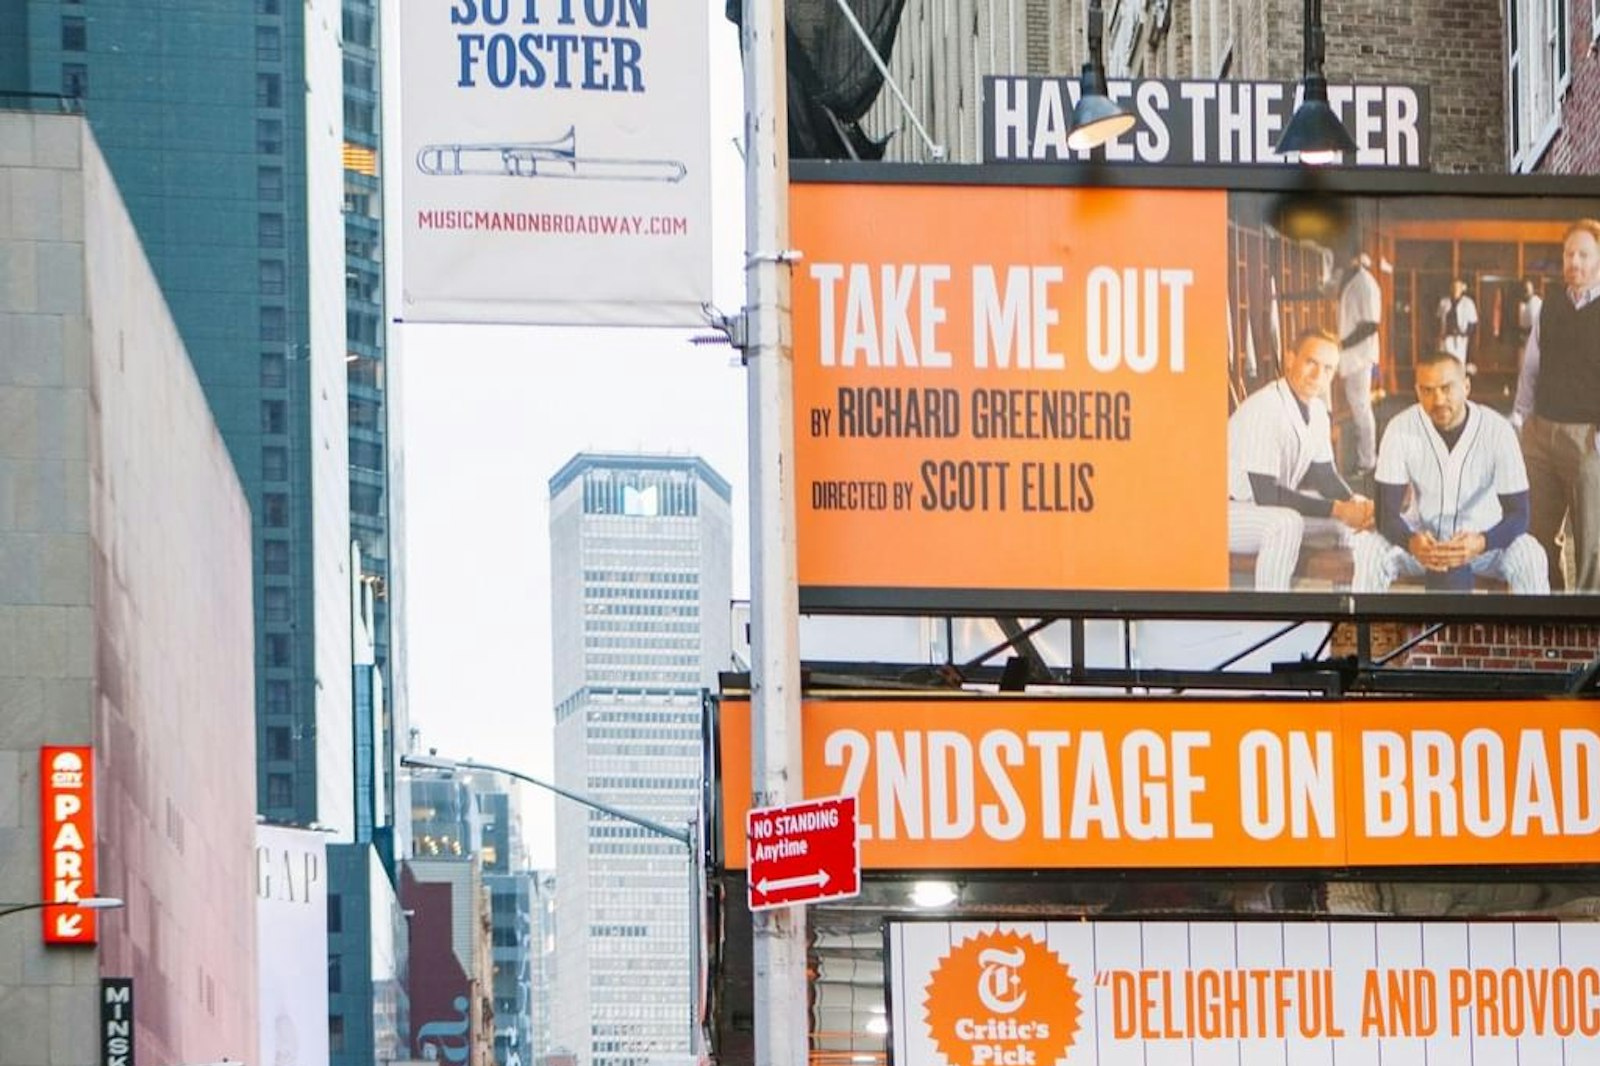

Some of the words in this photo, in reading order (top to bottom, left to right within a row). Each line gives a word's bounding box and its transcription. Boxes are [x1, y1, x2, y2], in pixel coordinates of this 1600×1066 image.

[457, 33, 645, 93] FOSTER
[418, 210, 688, 237] MUSICMANONBROADWAY.COM
[810, 264, 956, 370] TAKE
[973, 265, 1064, 371] ME
[1086, 267, 1193, 374] OUT
[811, 409, 831, 438] BY
[837, 387, 961, 440] RICHARD
[972, 389, 1132, 443] GREENBERG
[811, 480, 888, 512] DIRECTED
[893, 481, 913, 512] BY
[920, 461, 1009, 513] SCOTT
[1021, 462, 1096, 513] ELLIS
[824, 728, 1214, 842] 2NDSTAGE
[1238, 728, 1336, 840] ON
[52, 793, 85, 904] PARK
[754, 818, 774, 840] NO
[775, 807, 839, 837] STANDING
[755, 838, 809, 864] Anytime
[257, 846, 318, 904] GAP
[954, 1018, 1050, 1041] Critic's
[1361, 967, 1437, 1039] AND
[971, 1044, 1036, 1066] Pick
